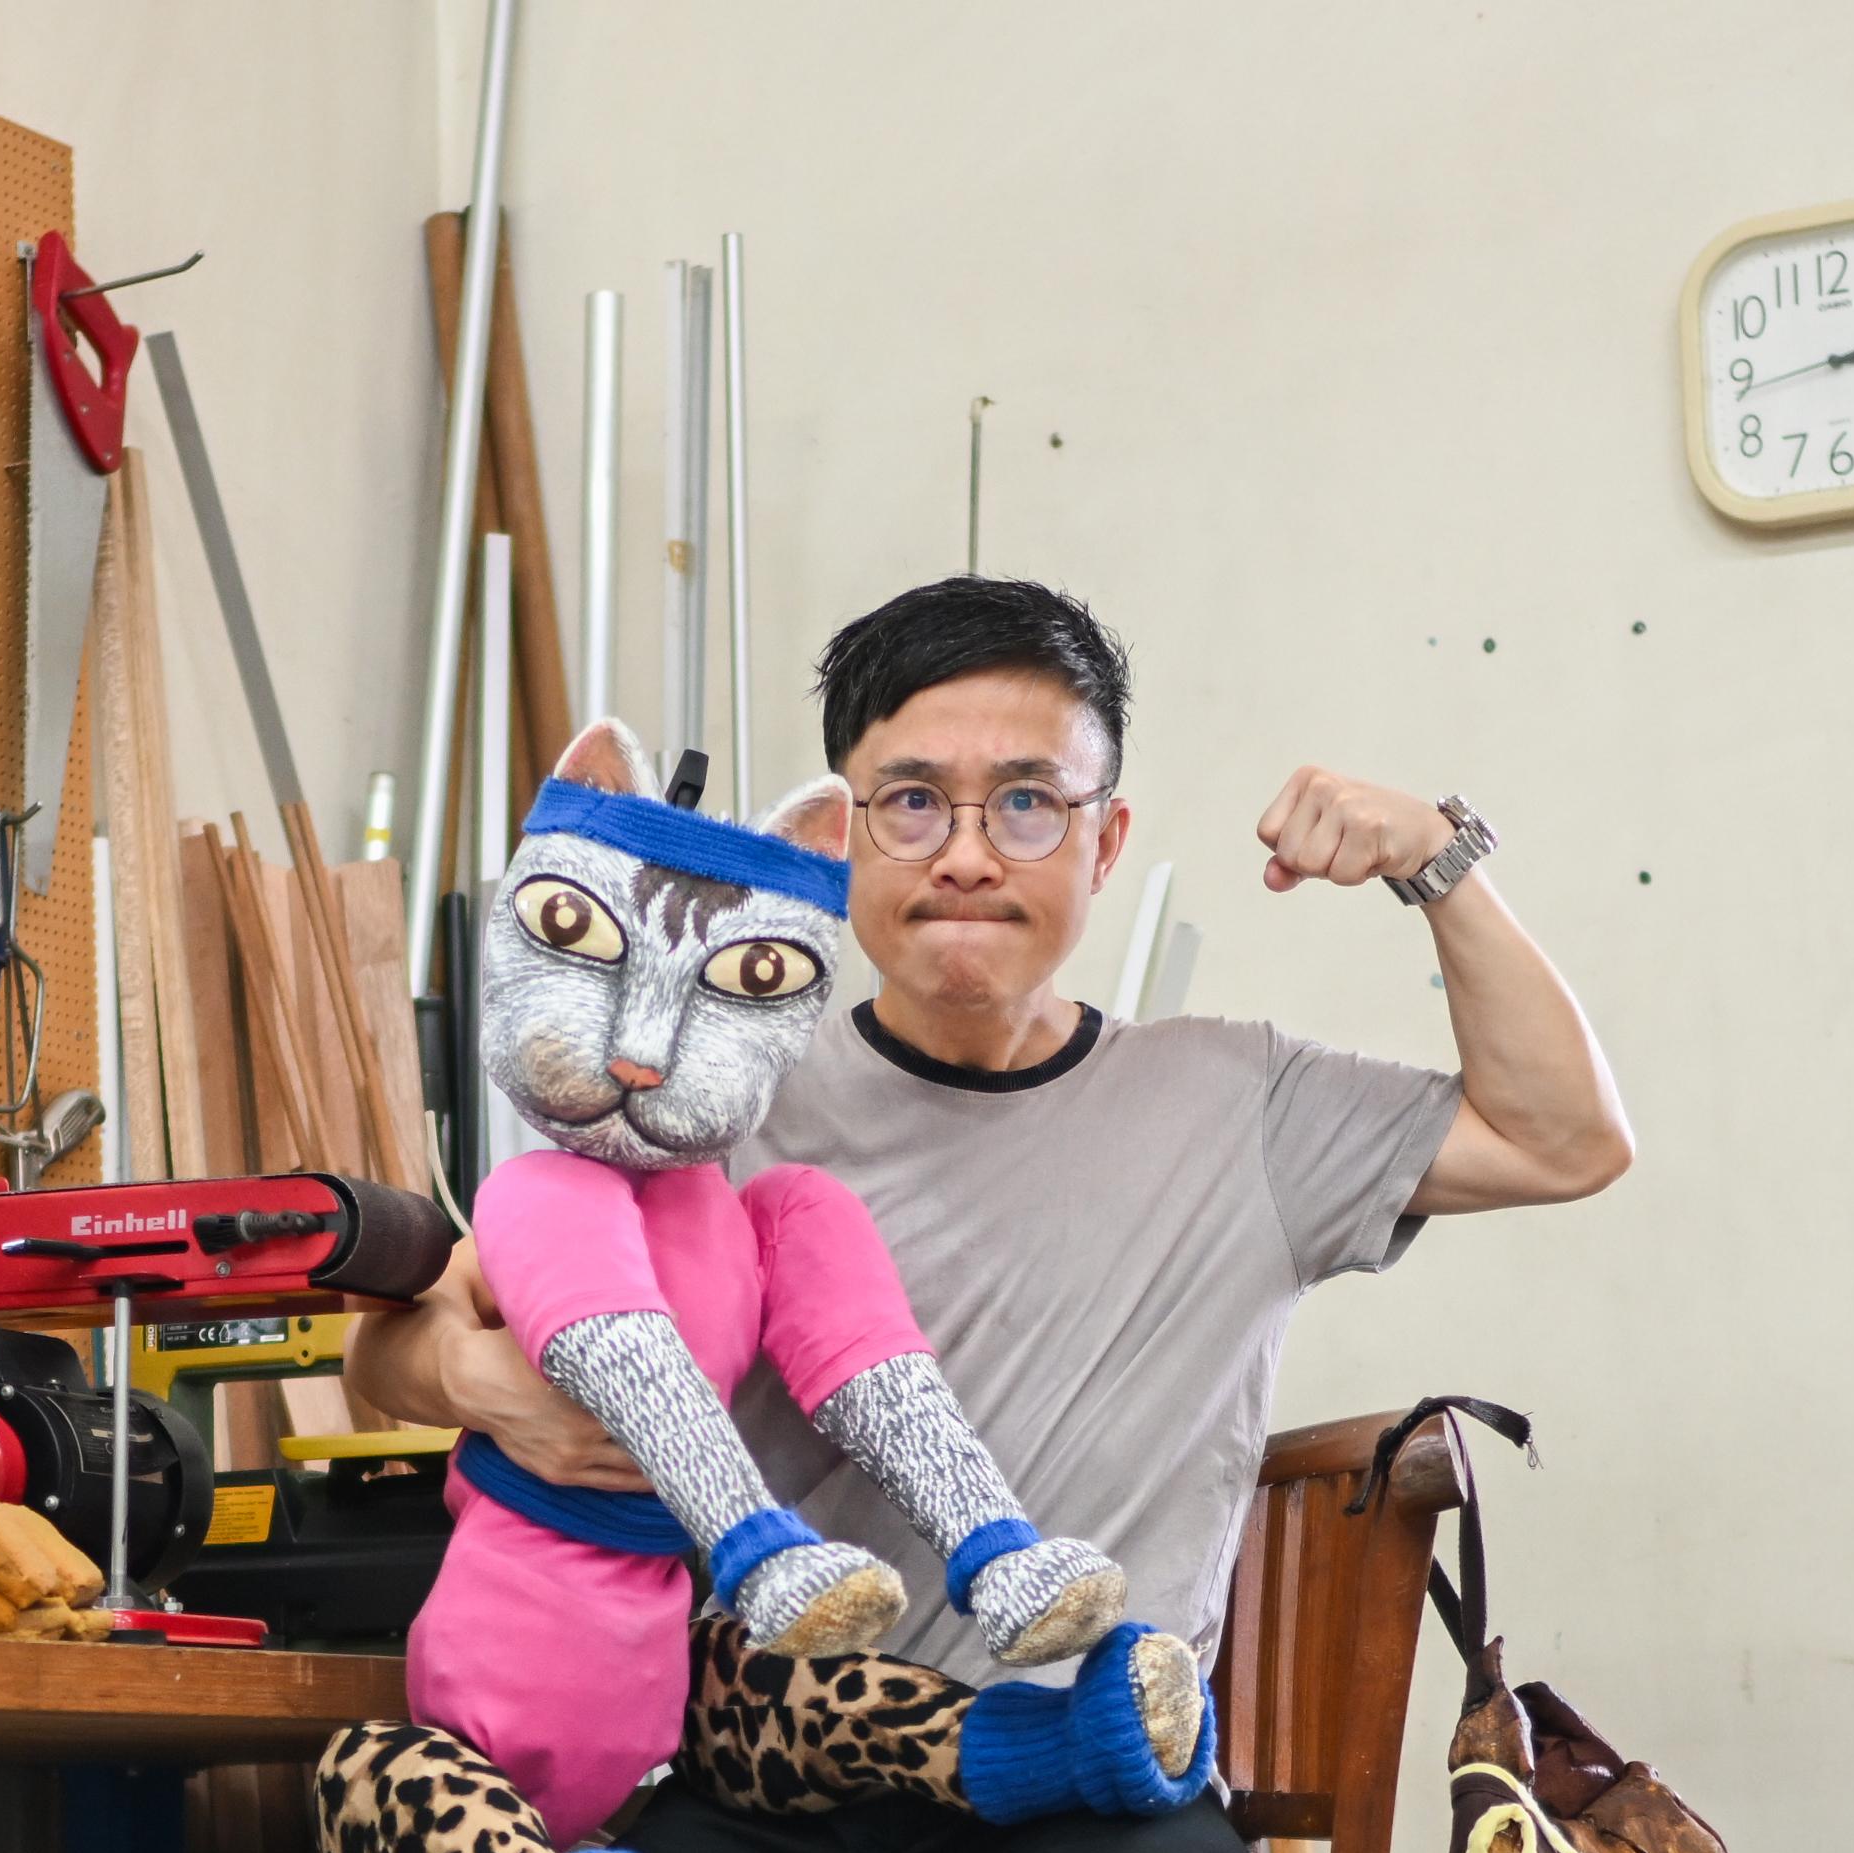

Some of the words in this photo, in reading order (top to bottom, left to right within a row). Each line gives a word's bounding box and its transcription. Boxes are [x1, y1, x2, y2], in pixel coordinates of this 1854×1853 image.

[1775, 262, 1800, 309] 11
[1816, 250, 1849, 297] 12
[1733, 295, 1767, 341] 10
[1729, 358, 1754, 402] 9
[1739, 413, 1763, 459] 8
[1782, 433, 1808, 478] 7
[1829, 431, 1854, 476] 6
[71, 1208, 187, 1236] Einhell
